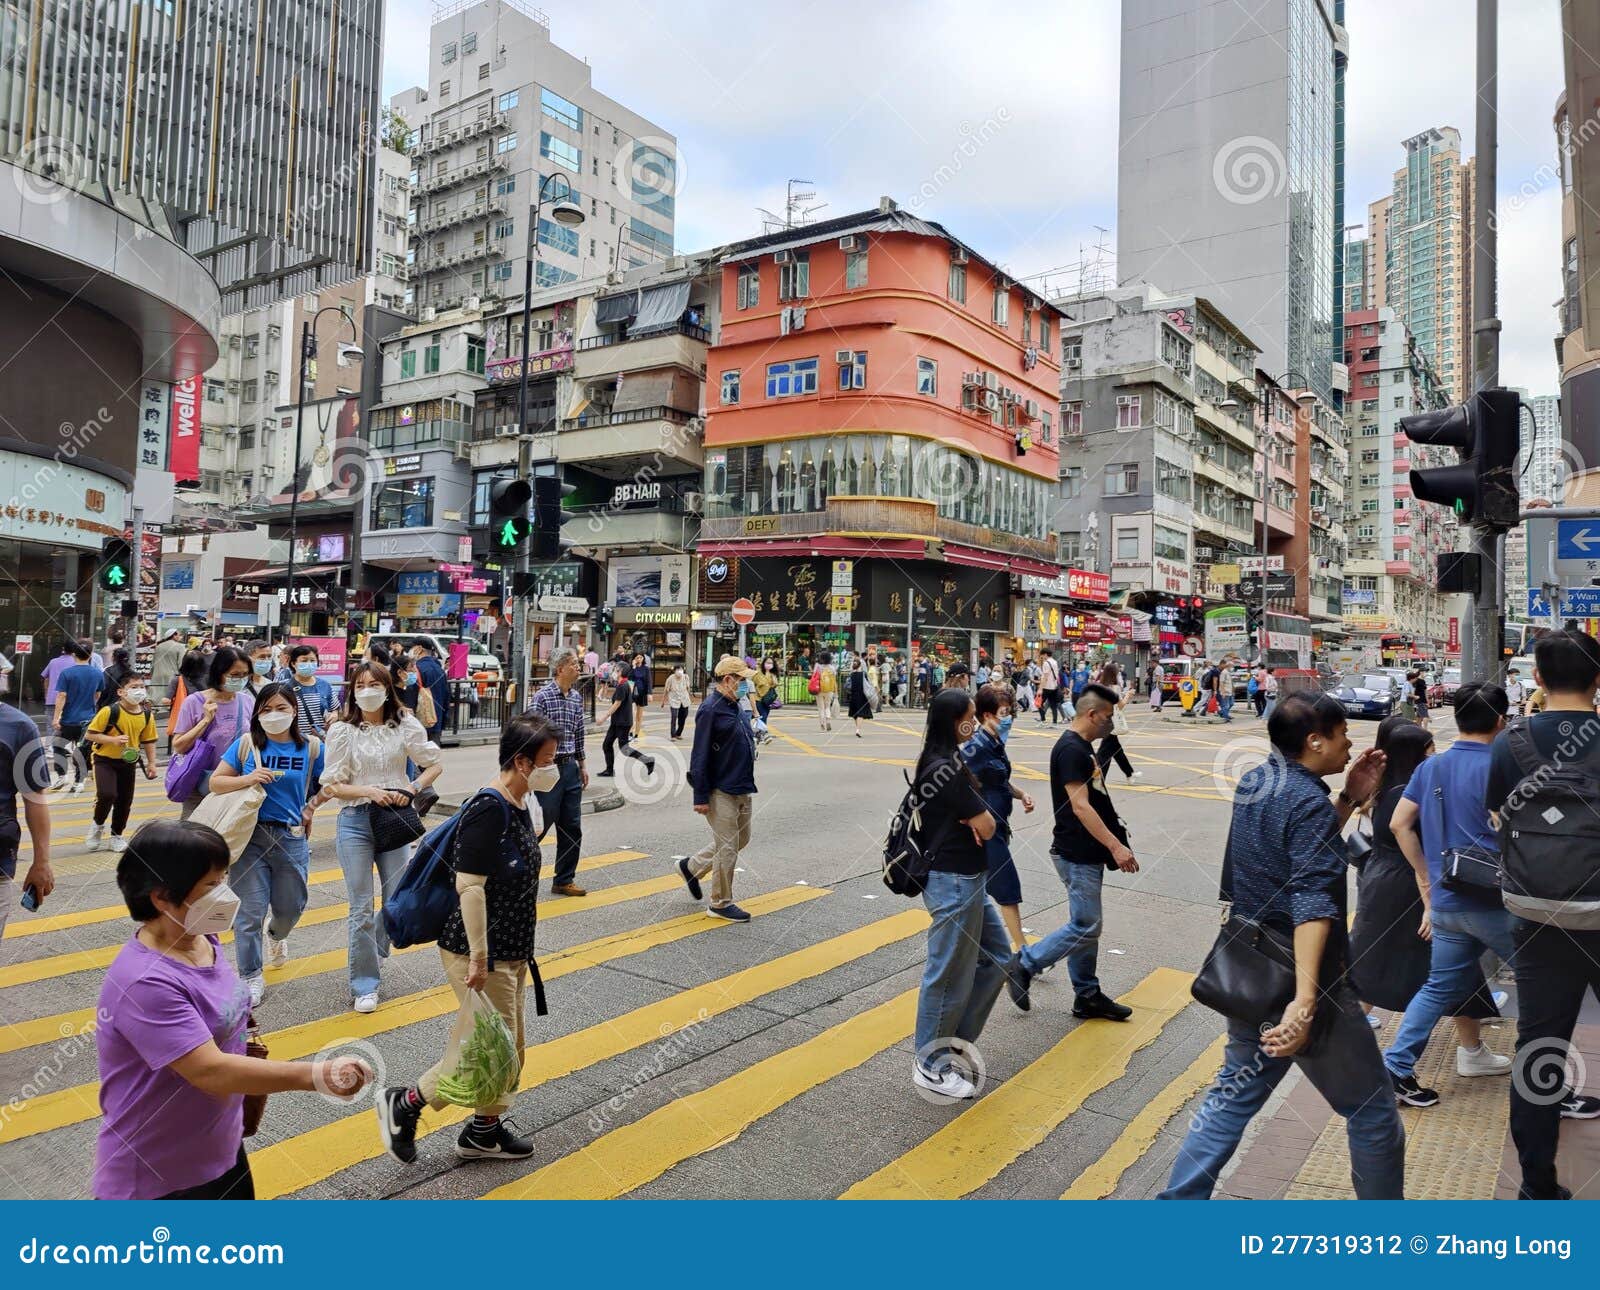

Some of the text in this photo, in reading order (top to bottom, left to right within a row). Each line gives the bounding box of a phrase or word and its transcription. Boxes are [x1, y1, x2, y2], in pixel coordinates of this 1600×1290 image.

[615, 482, 661, 501] BB HAIR
[747, 519, 776, 531] DEFY
[278, 587, 310, 605] 周大福
[635, 612, 653, 623] CITY
[655, 612, 682, 623] CHAIN
